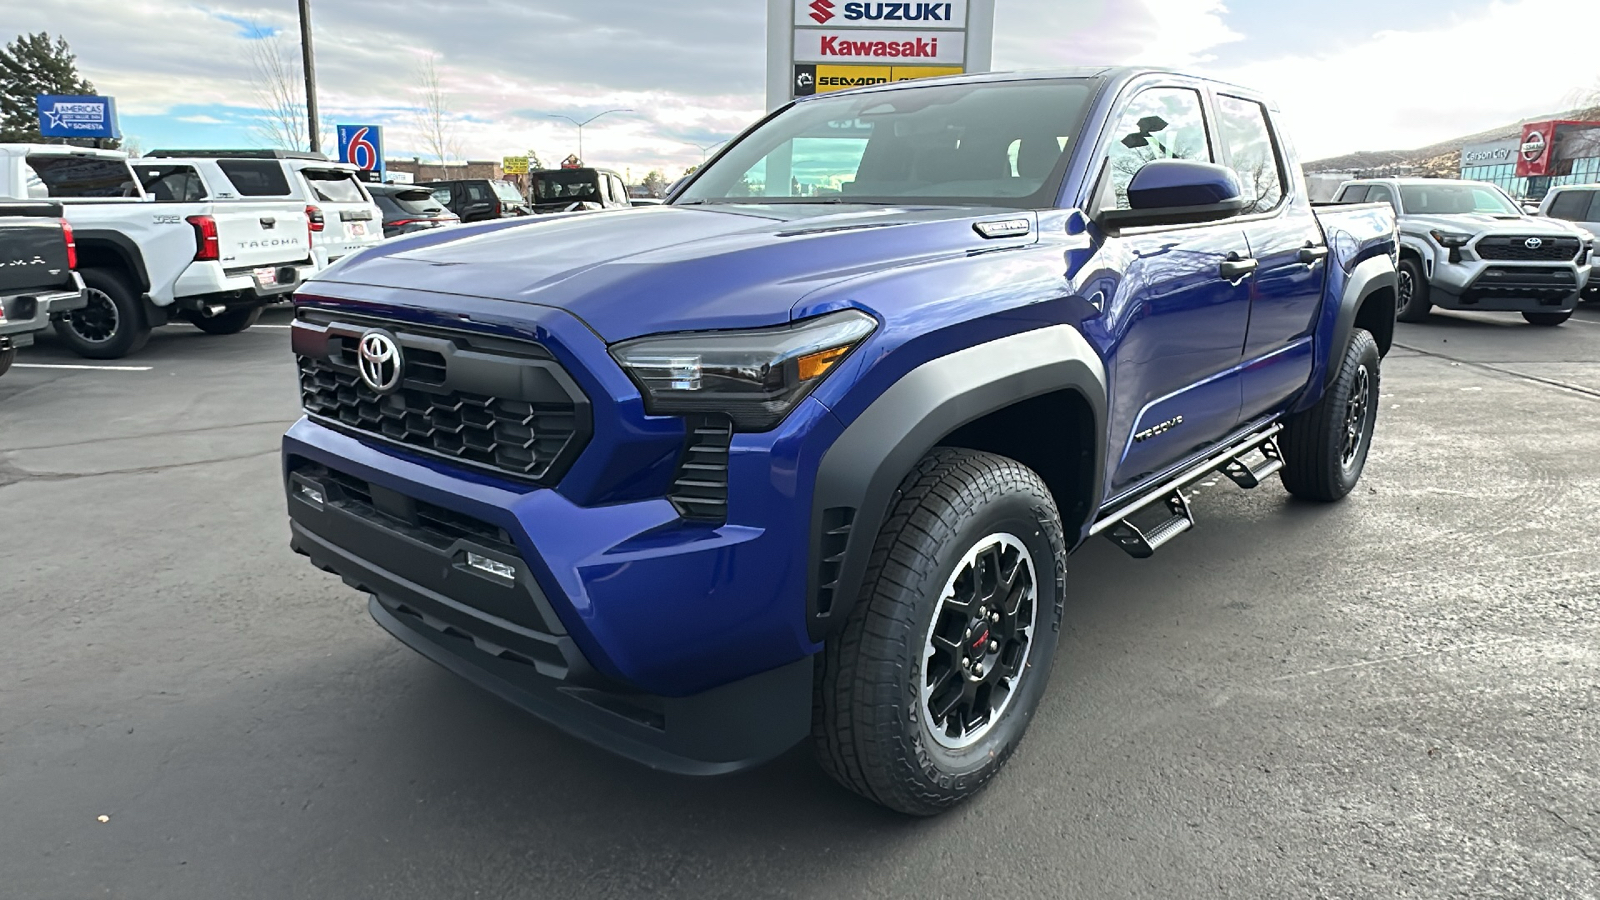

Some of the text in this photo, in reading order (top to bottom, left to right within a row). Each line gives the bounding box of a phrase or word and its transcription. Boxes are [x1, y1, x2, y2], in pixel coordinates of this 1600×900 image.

[844, 3, 951, 21] SUZUKI
[820, 36, 937, 57] Kawasaki
[60, 105, 102, 113] AMERICAS
[347, 127, 377, 170] 6
[1466, 147, 1510, 161] Carson City
[237, 237, 299, 249] TACOMA
